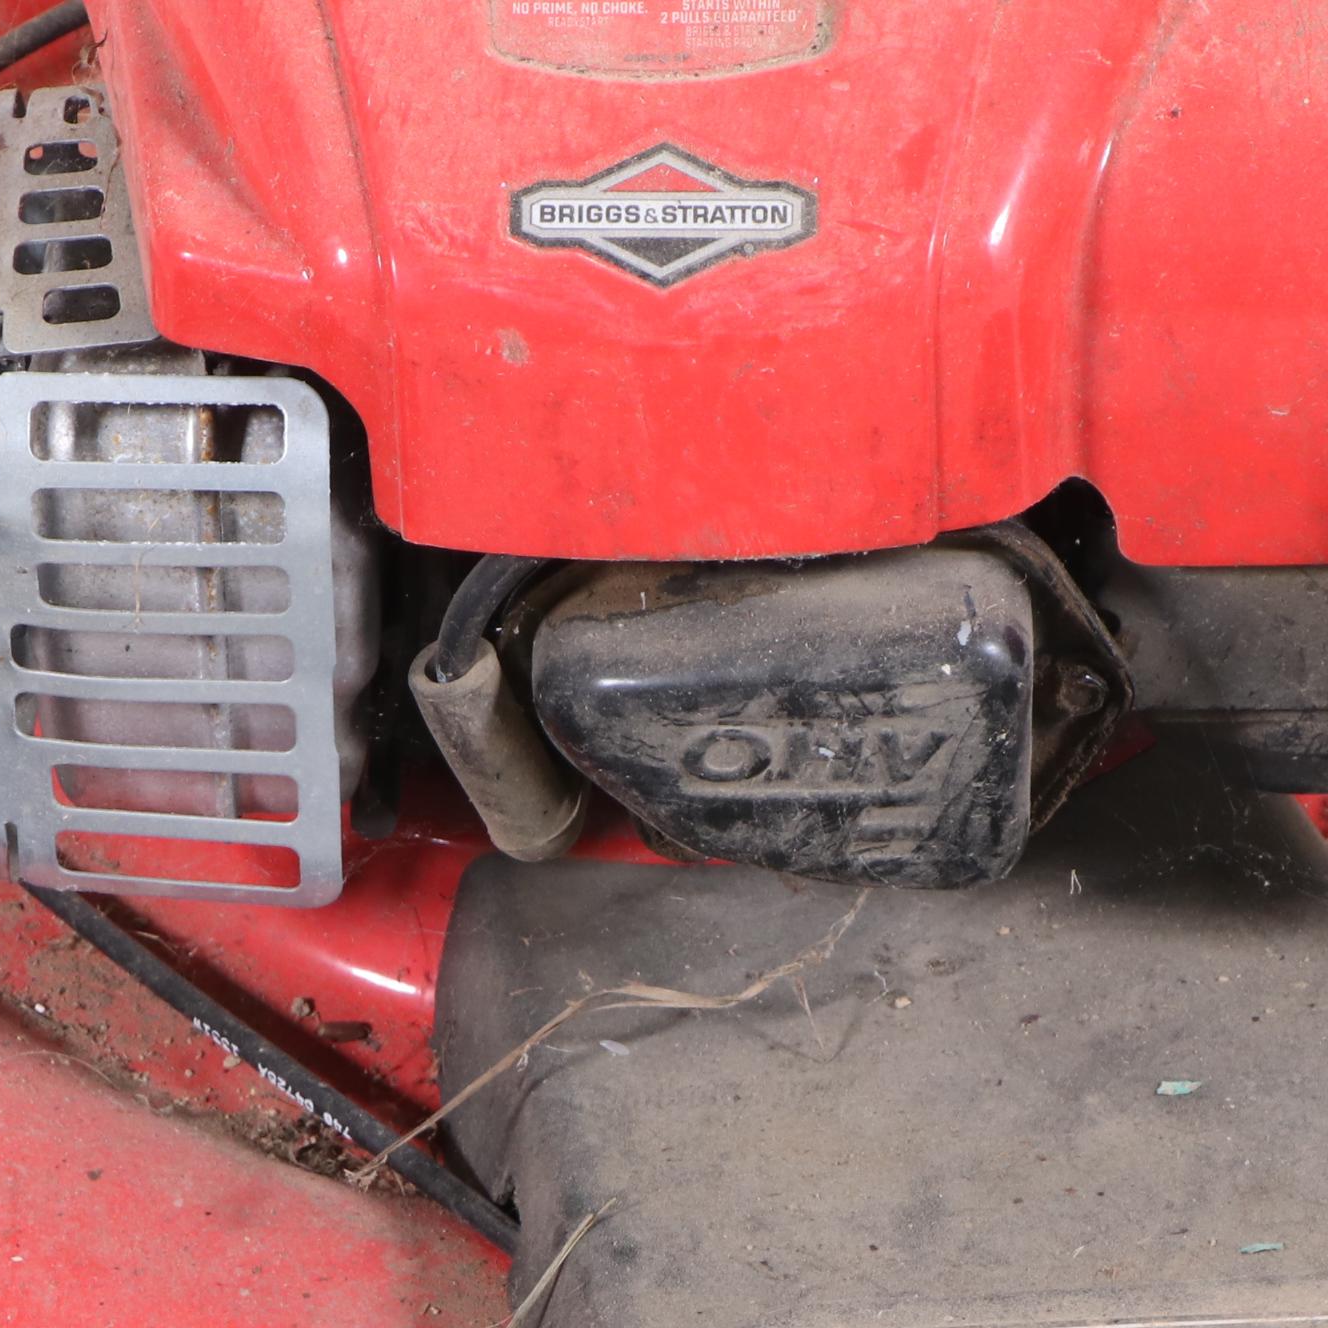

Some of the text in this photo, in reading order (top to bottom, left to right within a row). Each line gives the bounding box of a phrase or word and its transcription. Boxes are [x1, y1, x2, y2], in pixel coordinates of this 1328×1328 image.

[512, 2, 530, 15] NO
[580, 2, 598, 16] NO
[660, 11, 669, 25] 2
[671, 11, 710, 24] PULLS
[681, 726, 954, 784] OHV
